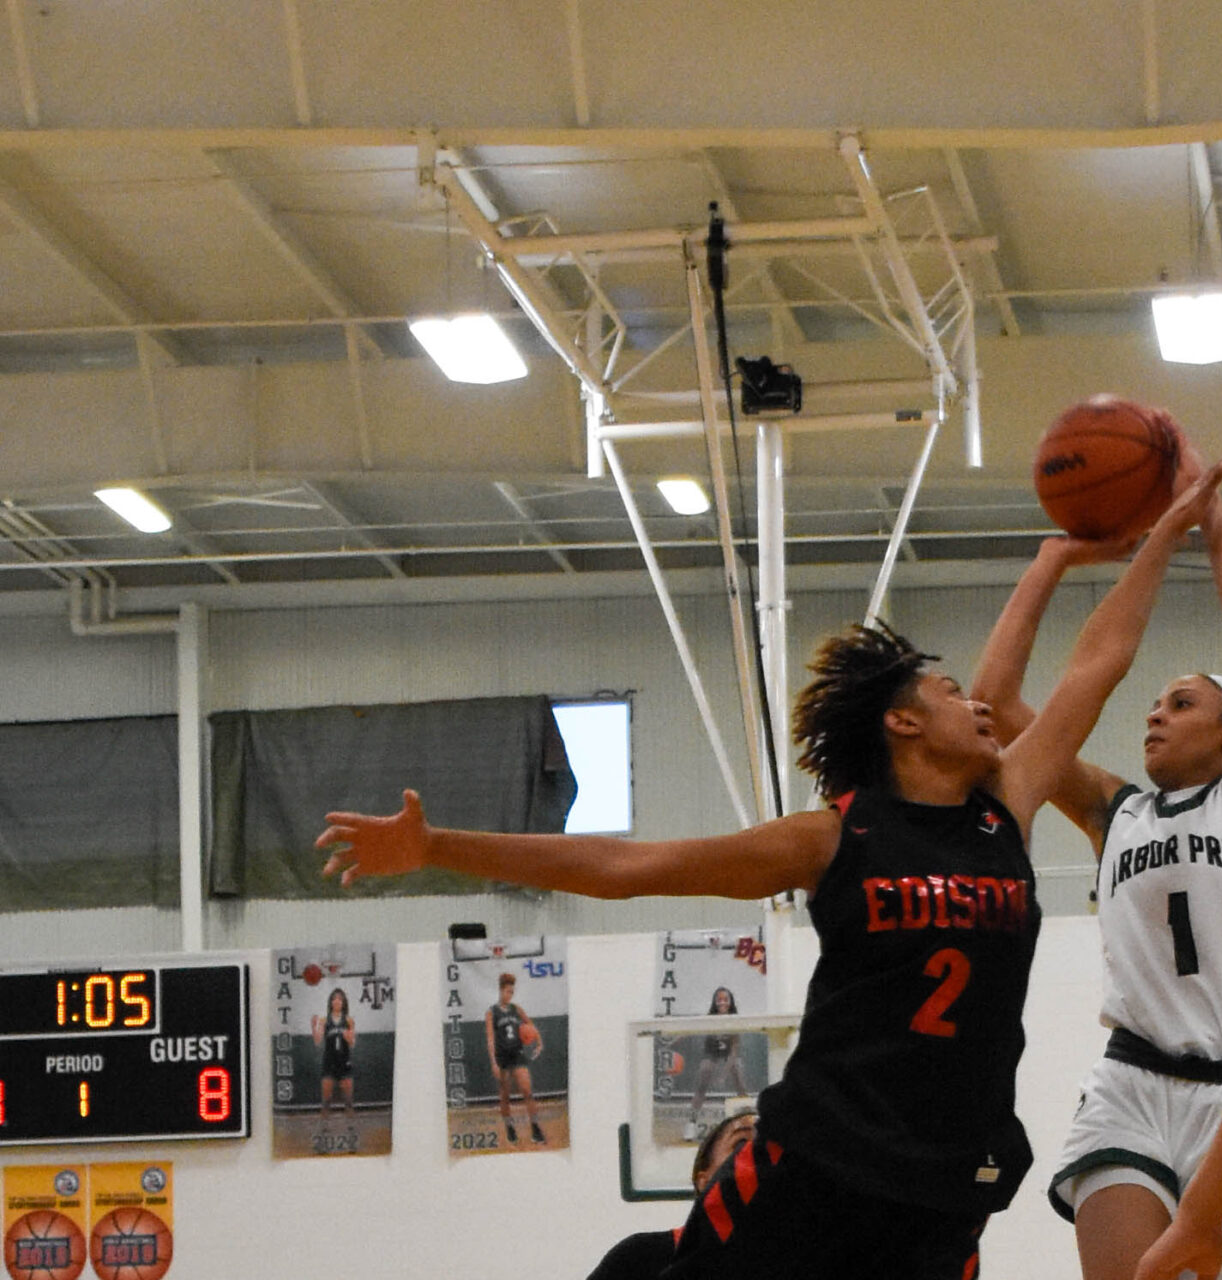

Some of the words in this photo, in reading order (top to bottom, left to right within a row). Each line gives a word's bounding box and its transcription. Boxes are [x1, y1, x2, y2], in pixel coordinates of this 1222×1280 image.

[862, 873, 1027, 933] EDISON
[1167, 890, 1199, 976] 1
[57, 972, 150, 1027] 1:05
[909, 947, 971, 1037] 2
[150, 1035, 228, 1062] GUEST
[277, 957, 294, 1101] GATORS
[446, 964, 467, 1109] GATORS
[46, 1055, 104, 1073] PERIOD
[79, 1082, 89, 1118] 1
[199, 1066, 230, 1121] 8
[451, 1132, 498, 1150] 2022
